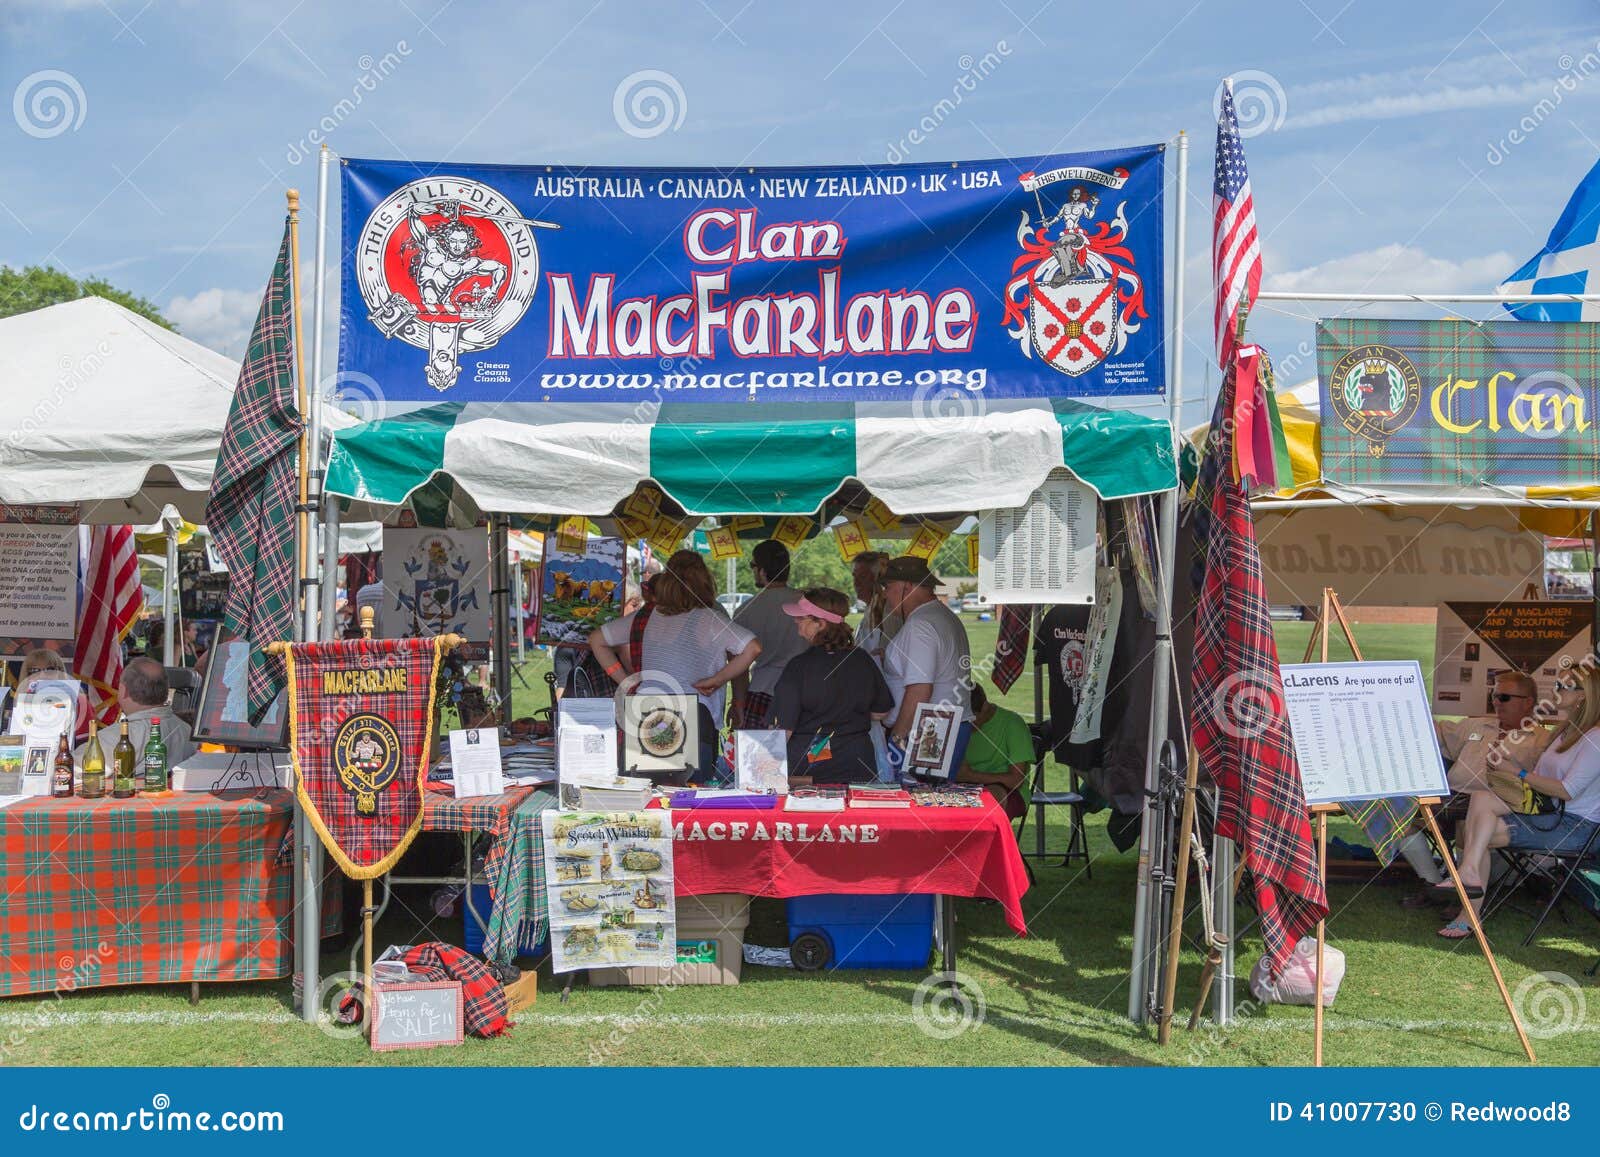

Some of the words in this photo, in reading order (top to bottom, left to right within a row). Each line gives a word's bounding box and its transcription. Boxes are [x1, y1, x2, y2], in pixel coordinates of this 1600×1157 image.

[534, 176, 644, 198] AUSTRALIA
[658, 178, 745, 199] CANADA
[760, 178, 807, 198] NEW
[815, 176, 908, 198] ZEALAND
[920, 173, 947, 193] UK
[961, 170, 1002, 190] USA
[1036, 173, 1056, 187] THIS
[1057, 169, 1083, 180] WE'LL
[1085, 170, 1117, 187] DEFEND
[365, 211, 393, 256] THIS
[470, 188, 531, 259] DEFEND
[685, 209, 847, 265] Clan
[547, 267, 979, 359] MacFarlane
[1366, 347, 1384, 357] AN
[540, 366, 987, 394] www.macfarlane.org
[1430, 371, 1591, 434] Clan
[1486, 618, 1506, 626] AND
[1505, 630, 1534, 639] GOOD
[324, 669, 407, 695] MACFARLANE
[1281, 674, 1339, 688] cLarens
[1344, 677, 1359, 686] Are
[1361, 679, 1375, 687] you
[1394, 675, 1402, 686] of
[1404, 674, 1415, 684] us?
[568, 828, 605, 847] Scotch
[604, 826, 651, 841] Whisky
[671, 820, 880, 844] MACFARLANE
